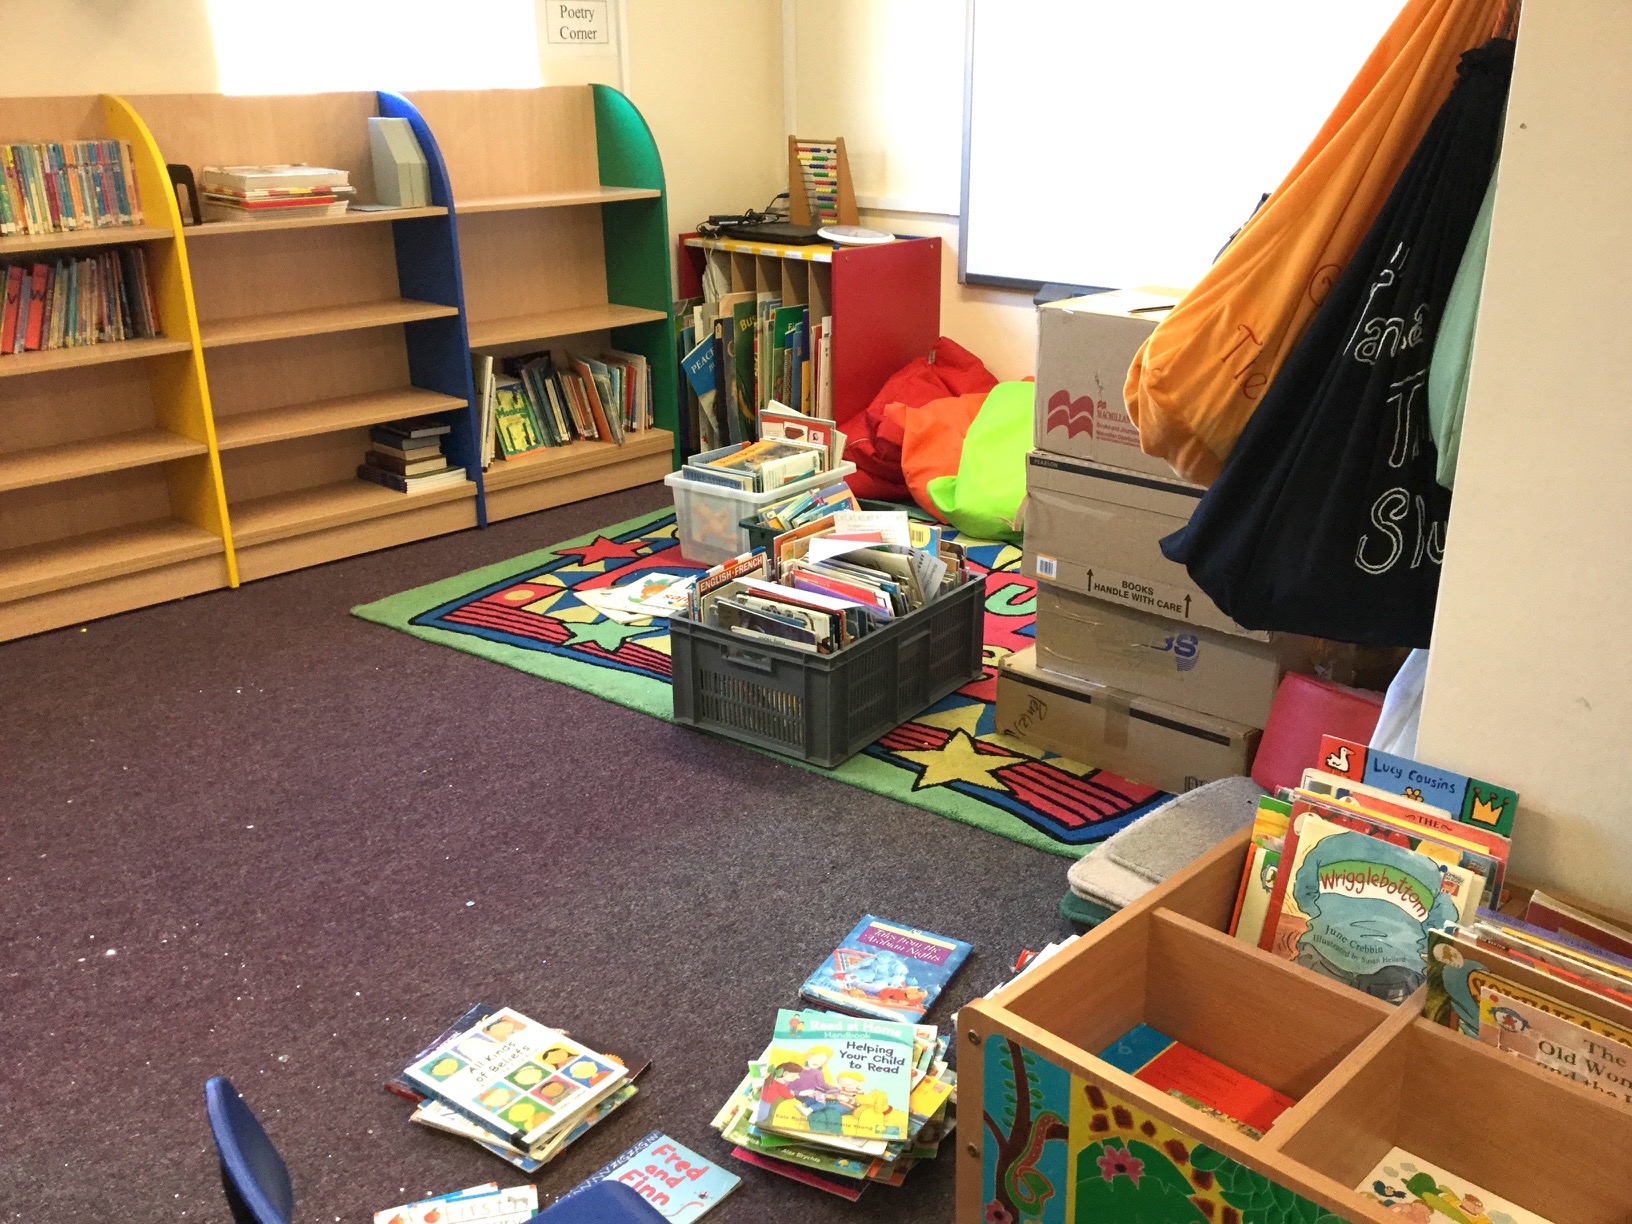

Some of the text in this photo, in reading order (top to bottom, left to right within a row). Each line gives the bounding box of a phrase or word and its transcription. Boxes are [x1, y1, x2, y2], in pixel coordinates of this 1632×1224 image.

[560, 5, 595, 22] Poetry
[560, 26, 598, 40] Corner
[1034, 459, 1059, 469] PEARSON
[700, 555, 763, 592] ENGLISH FRENCH
[1094, 583, 1183, 613] HANDLE WITH CARE
[1121, 580, 1154, 596] BOOKS
[1373, 757, 1456, 794] Lucy Cousins
[1418, 815, 1440, 829] THE
[1320, 866, 1428, 918] Wrigglebottom
[874, 929, 896, 940] Tales
[1325, 925, 1384, 955] June Crebbin
[906, 946, 940, 962] Nights
[1313, 934, 1351, 958] Illustrated
[1361, 955, 1381, 965] Susan
[810, 1020, 843, 1031] Read
[846, 1021, 859, 1032] at
[863, 1022, 903, 1037] Home
[824, 1031, 871, 1039] Handbook
[469, 1061, 486, 1074] All
[484, 1041, 516, 1062] Kinds
[839, 1050, 905, 1066] Your Child
[846, 1041, 894, 1057] Helping
[1538, 1040, 1577, 1066] Old
[1583, 1039, 1627, 1068] The
[476, 1071, 488, 1083] of
[488, 1045, 531, 1073] Beliefs
[849, 1061, 900, 1075] to Read
[651, 1143, 710, 1181] Fred
[618, 1168, 670, 1206] Finn
[645, 1164, 686, 1189] and
[445, 1200, 503, 1222] First
